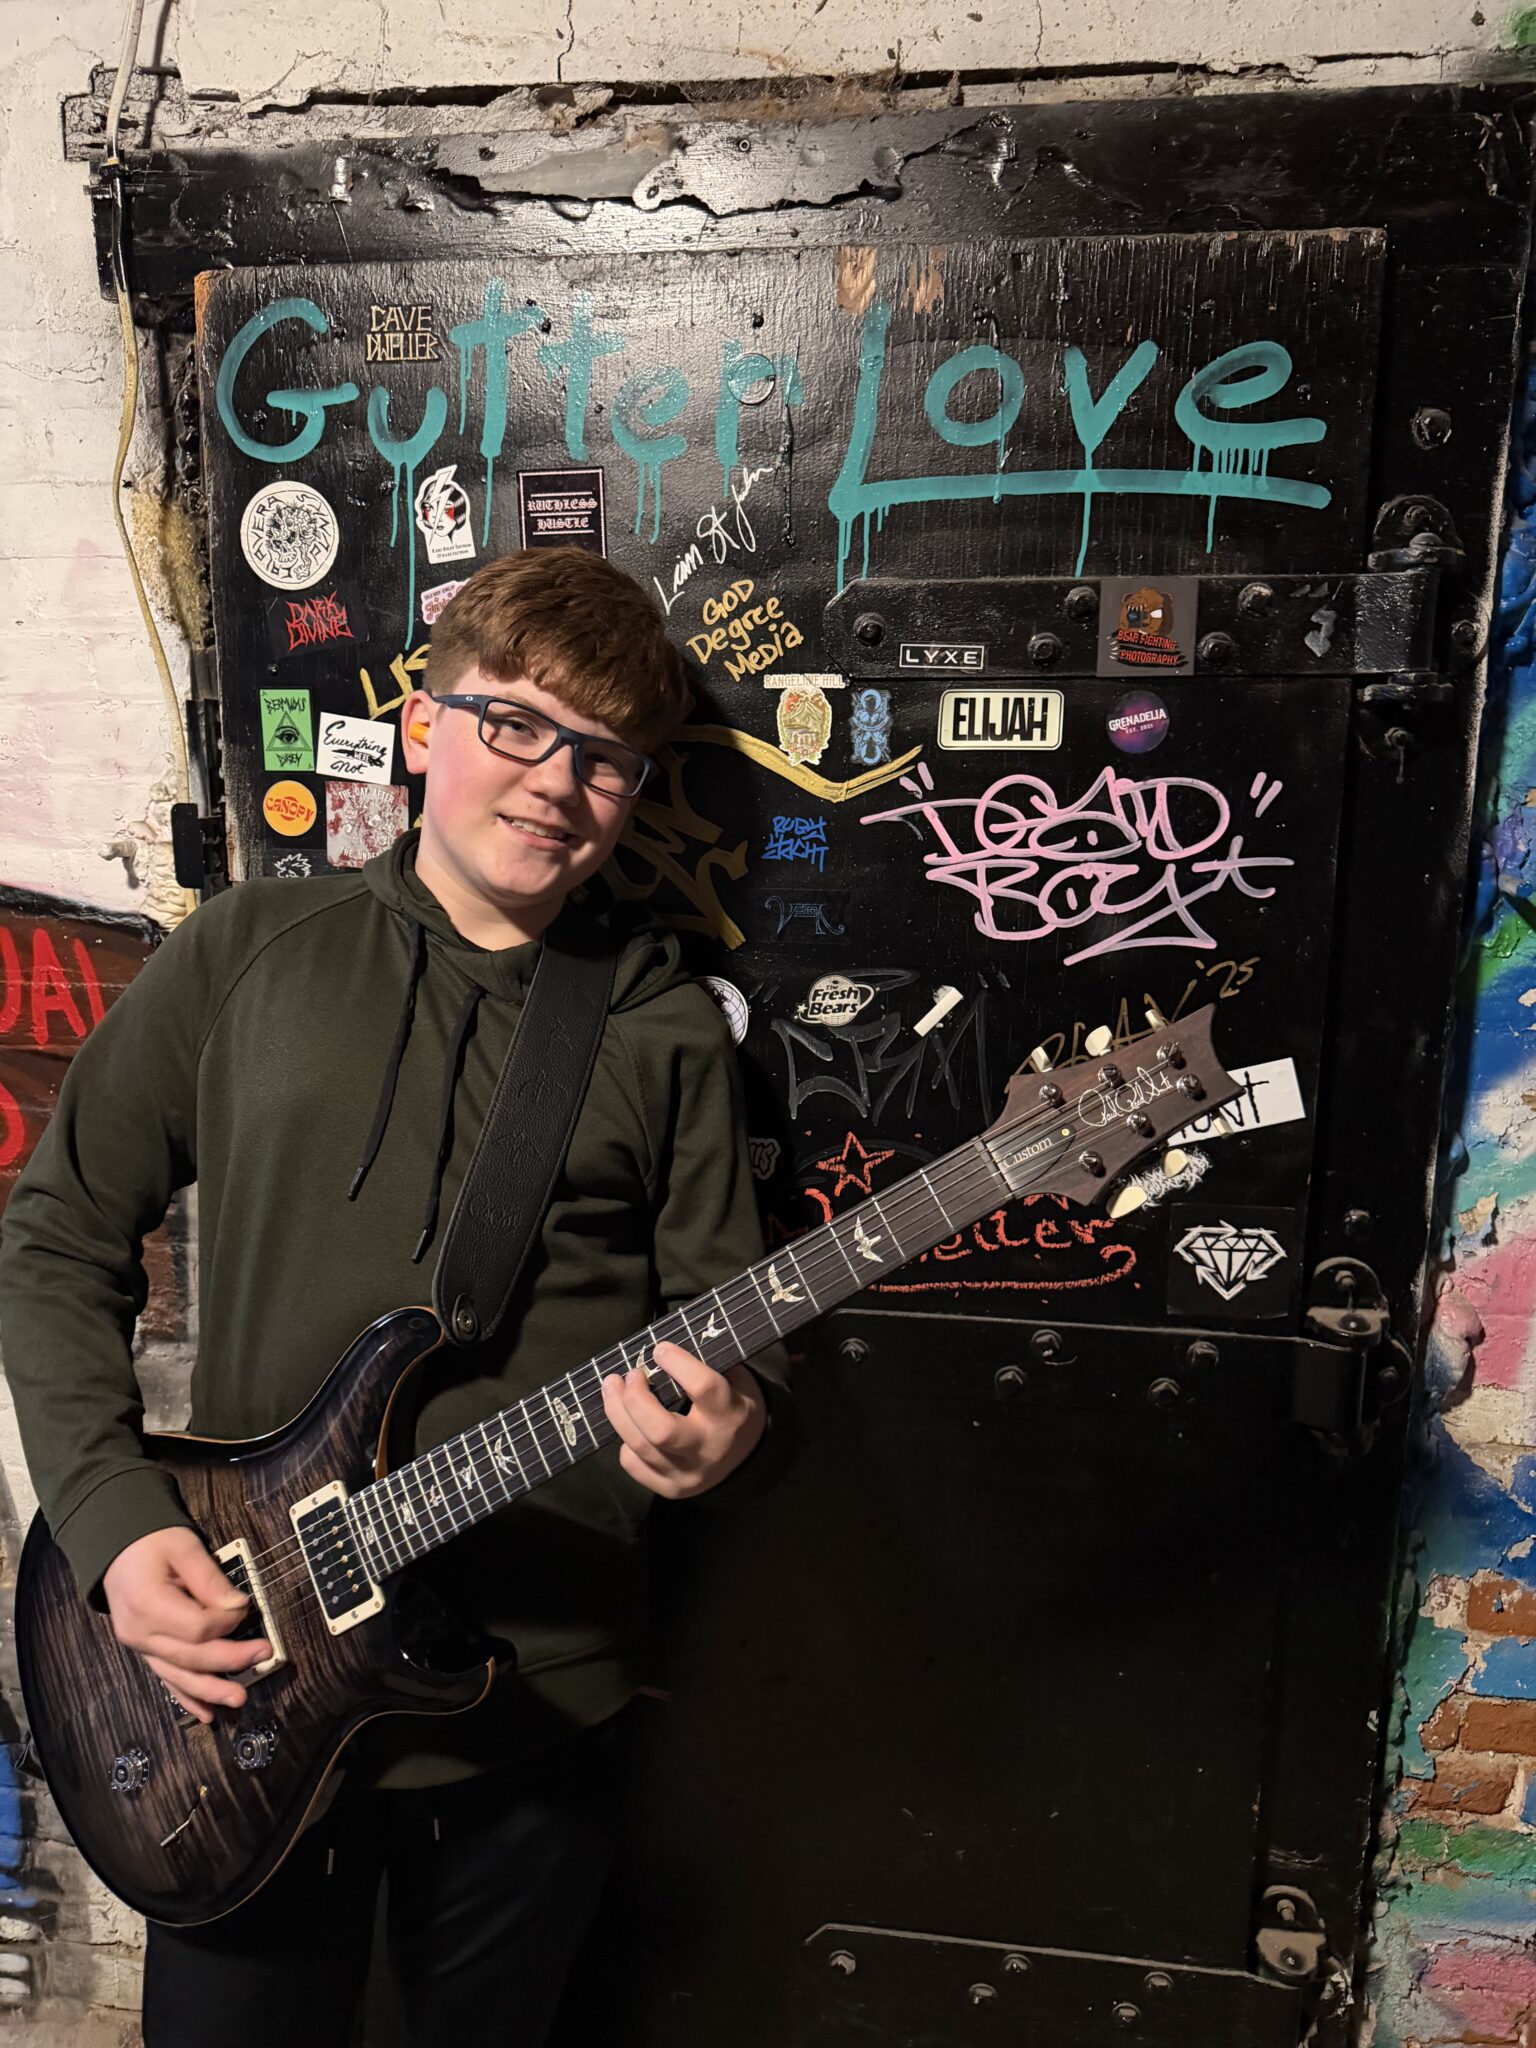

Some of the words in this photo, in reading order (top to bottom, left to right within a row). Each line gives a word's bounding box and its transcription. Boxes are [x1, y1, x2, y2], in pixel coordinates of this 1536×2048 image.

[370, 305, 433, 332] CAVE
[215, 277, 804, 472] Gutter
[827, 300, 1340, 520] Love
[526, 497, 599, 512] RUTHLESS
[536, 516, 590, 531] HUSTLE
[686, 597, 784, 665] Degree
[905, 650, 978, 665] LYXE
[1120, 650, 1179, 665] PHOTOGRAPHY
[951, 697, 1049, 742] ELIJAH
[1108, 708, 1167, 732] GRENADELIA
[338, 788, 353, 801] THE
[355, 786, 369, 797] DAY
[372, 788, 396, 804] AFTER
[265, 796, 314, 823] CANOPY
[812, 986, 859, 1002] Fresh
[809, 1002, 859, 1016] Bears
[1003, 1136, 1054, 1169] Custom
